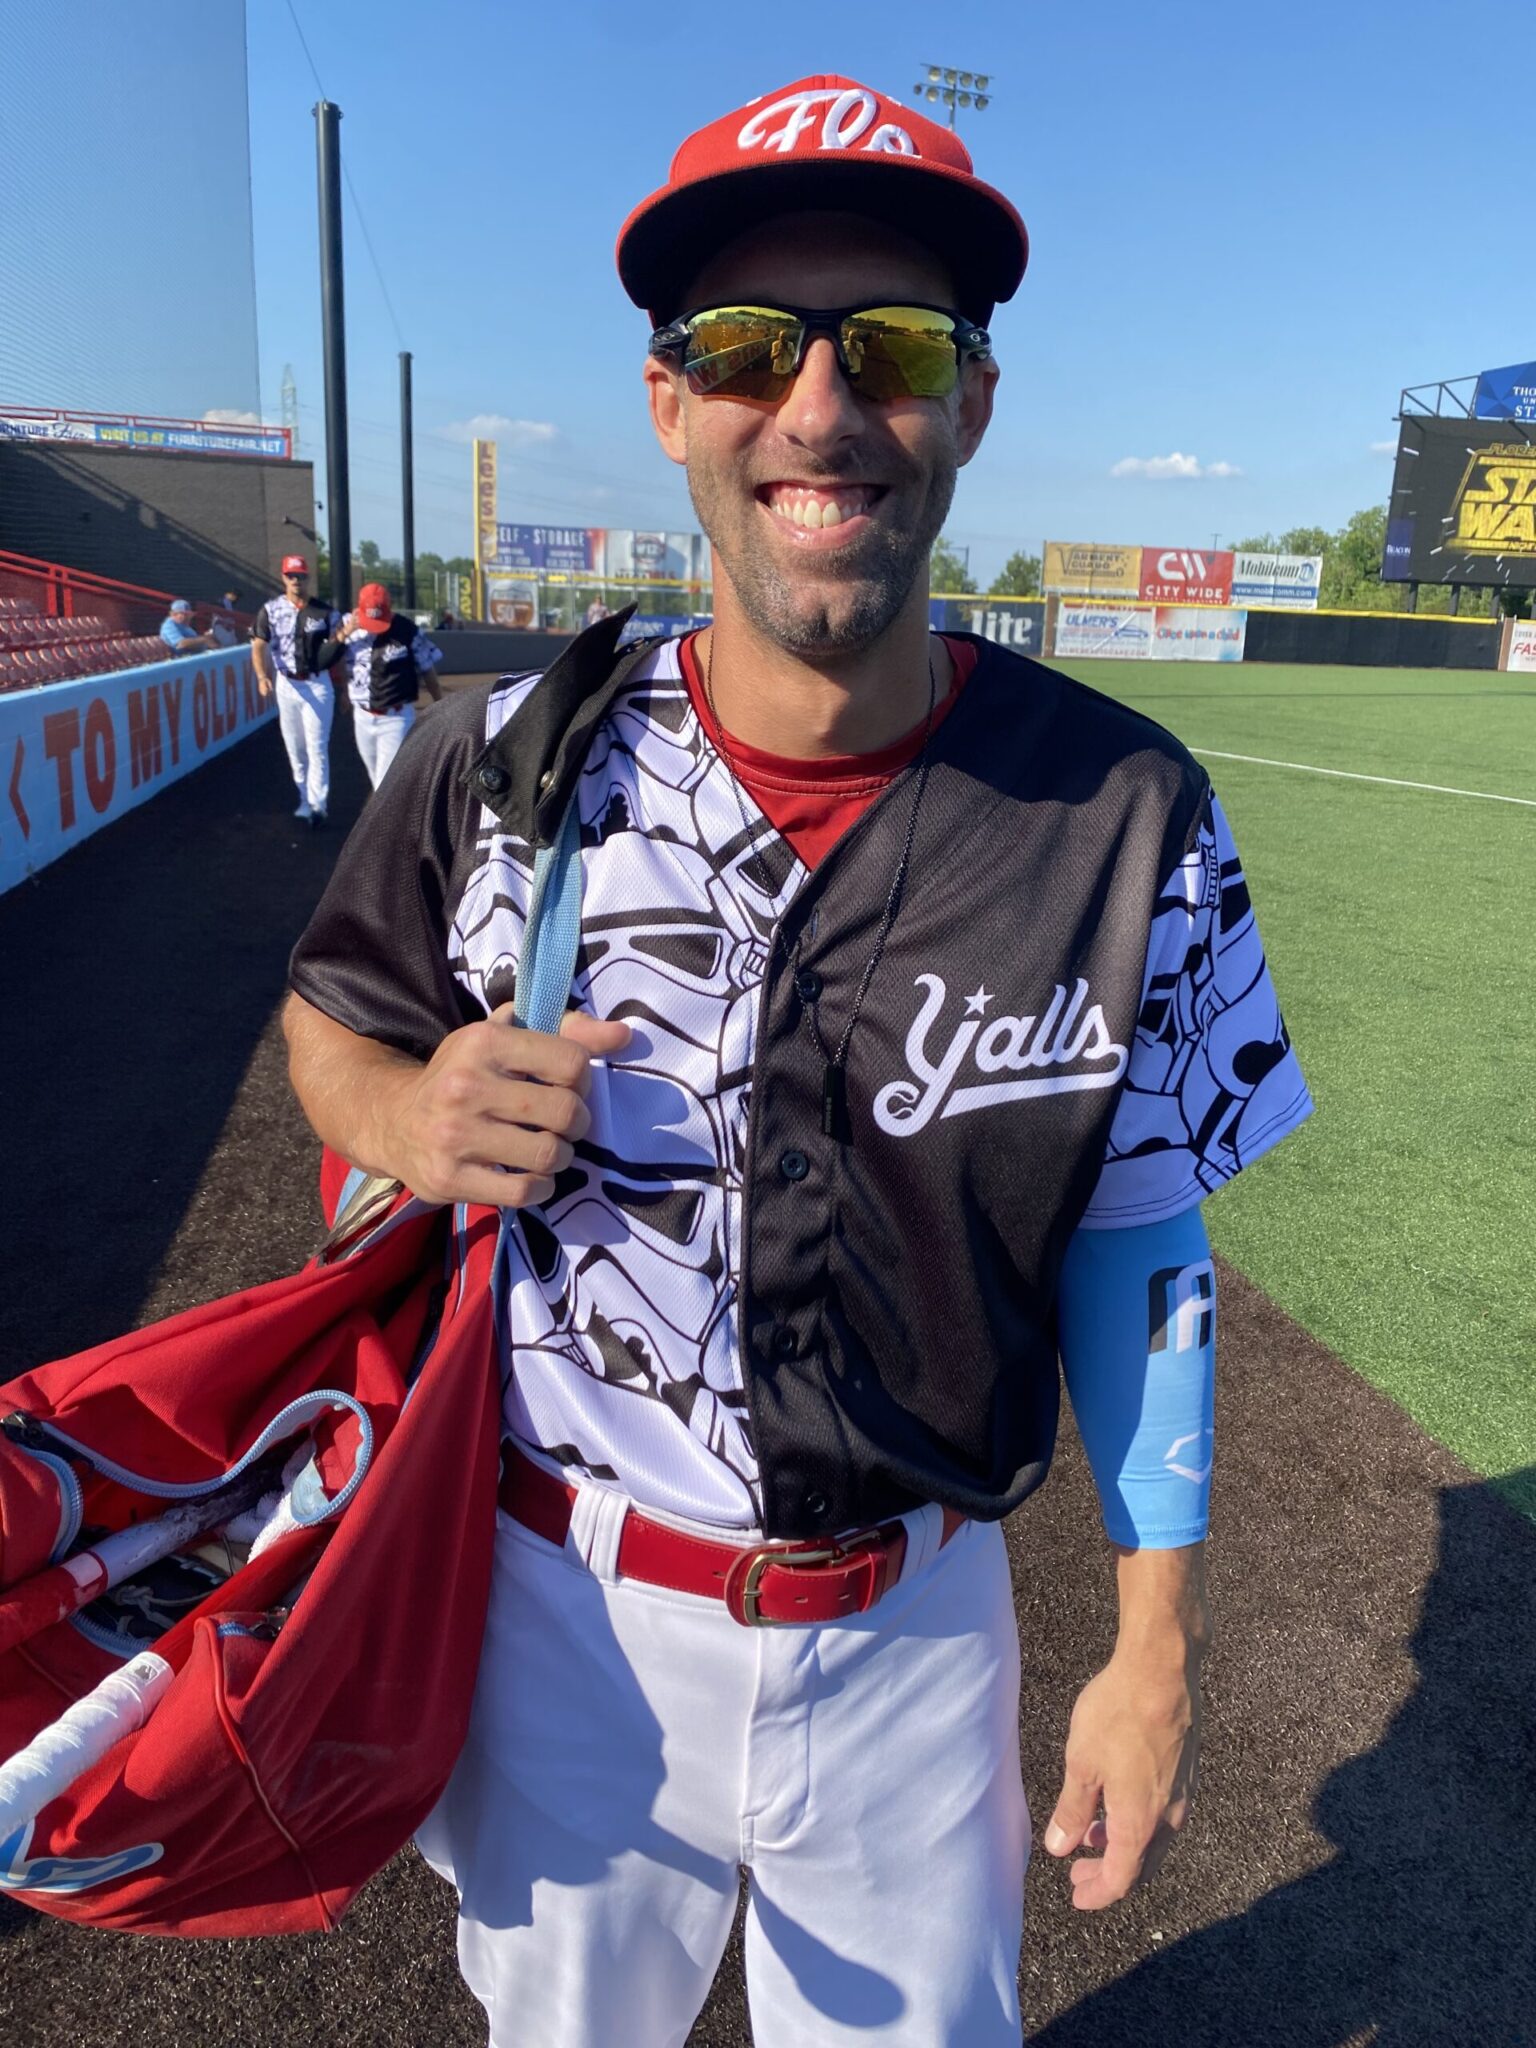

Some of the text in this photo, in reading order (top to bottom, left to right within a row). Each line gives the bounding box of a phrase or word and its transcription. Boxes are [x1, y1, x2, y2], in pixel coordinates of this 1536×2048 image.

[1515, 405, 1536, 418] ST
[1489, 443, 1536, 457] FLORE
[1145, 584, 1223, 598] CITY WIDE
[44, 697, 117, 832] TO
[128, 678, 182, 791] MY
[193, 664, 237, 752] OLD
